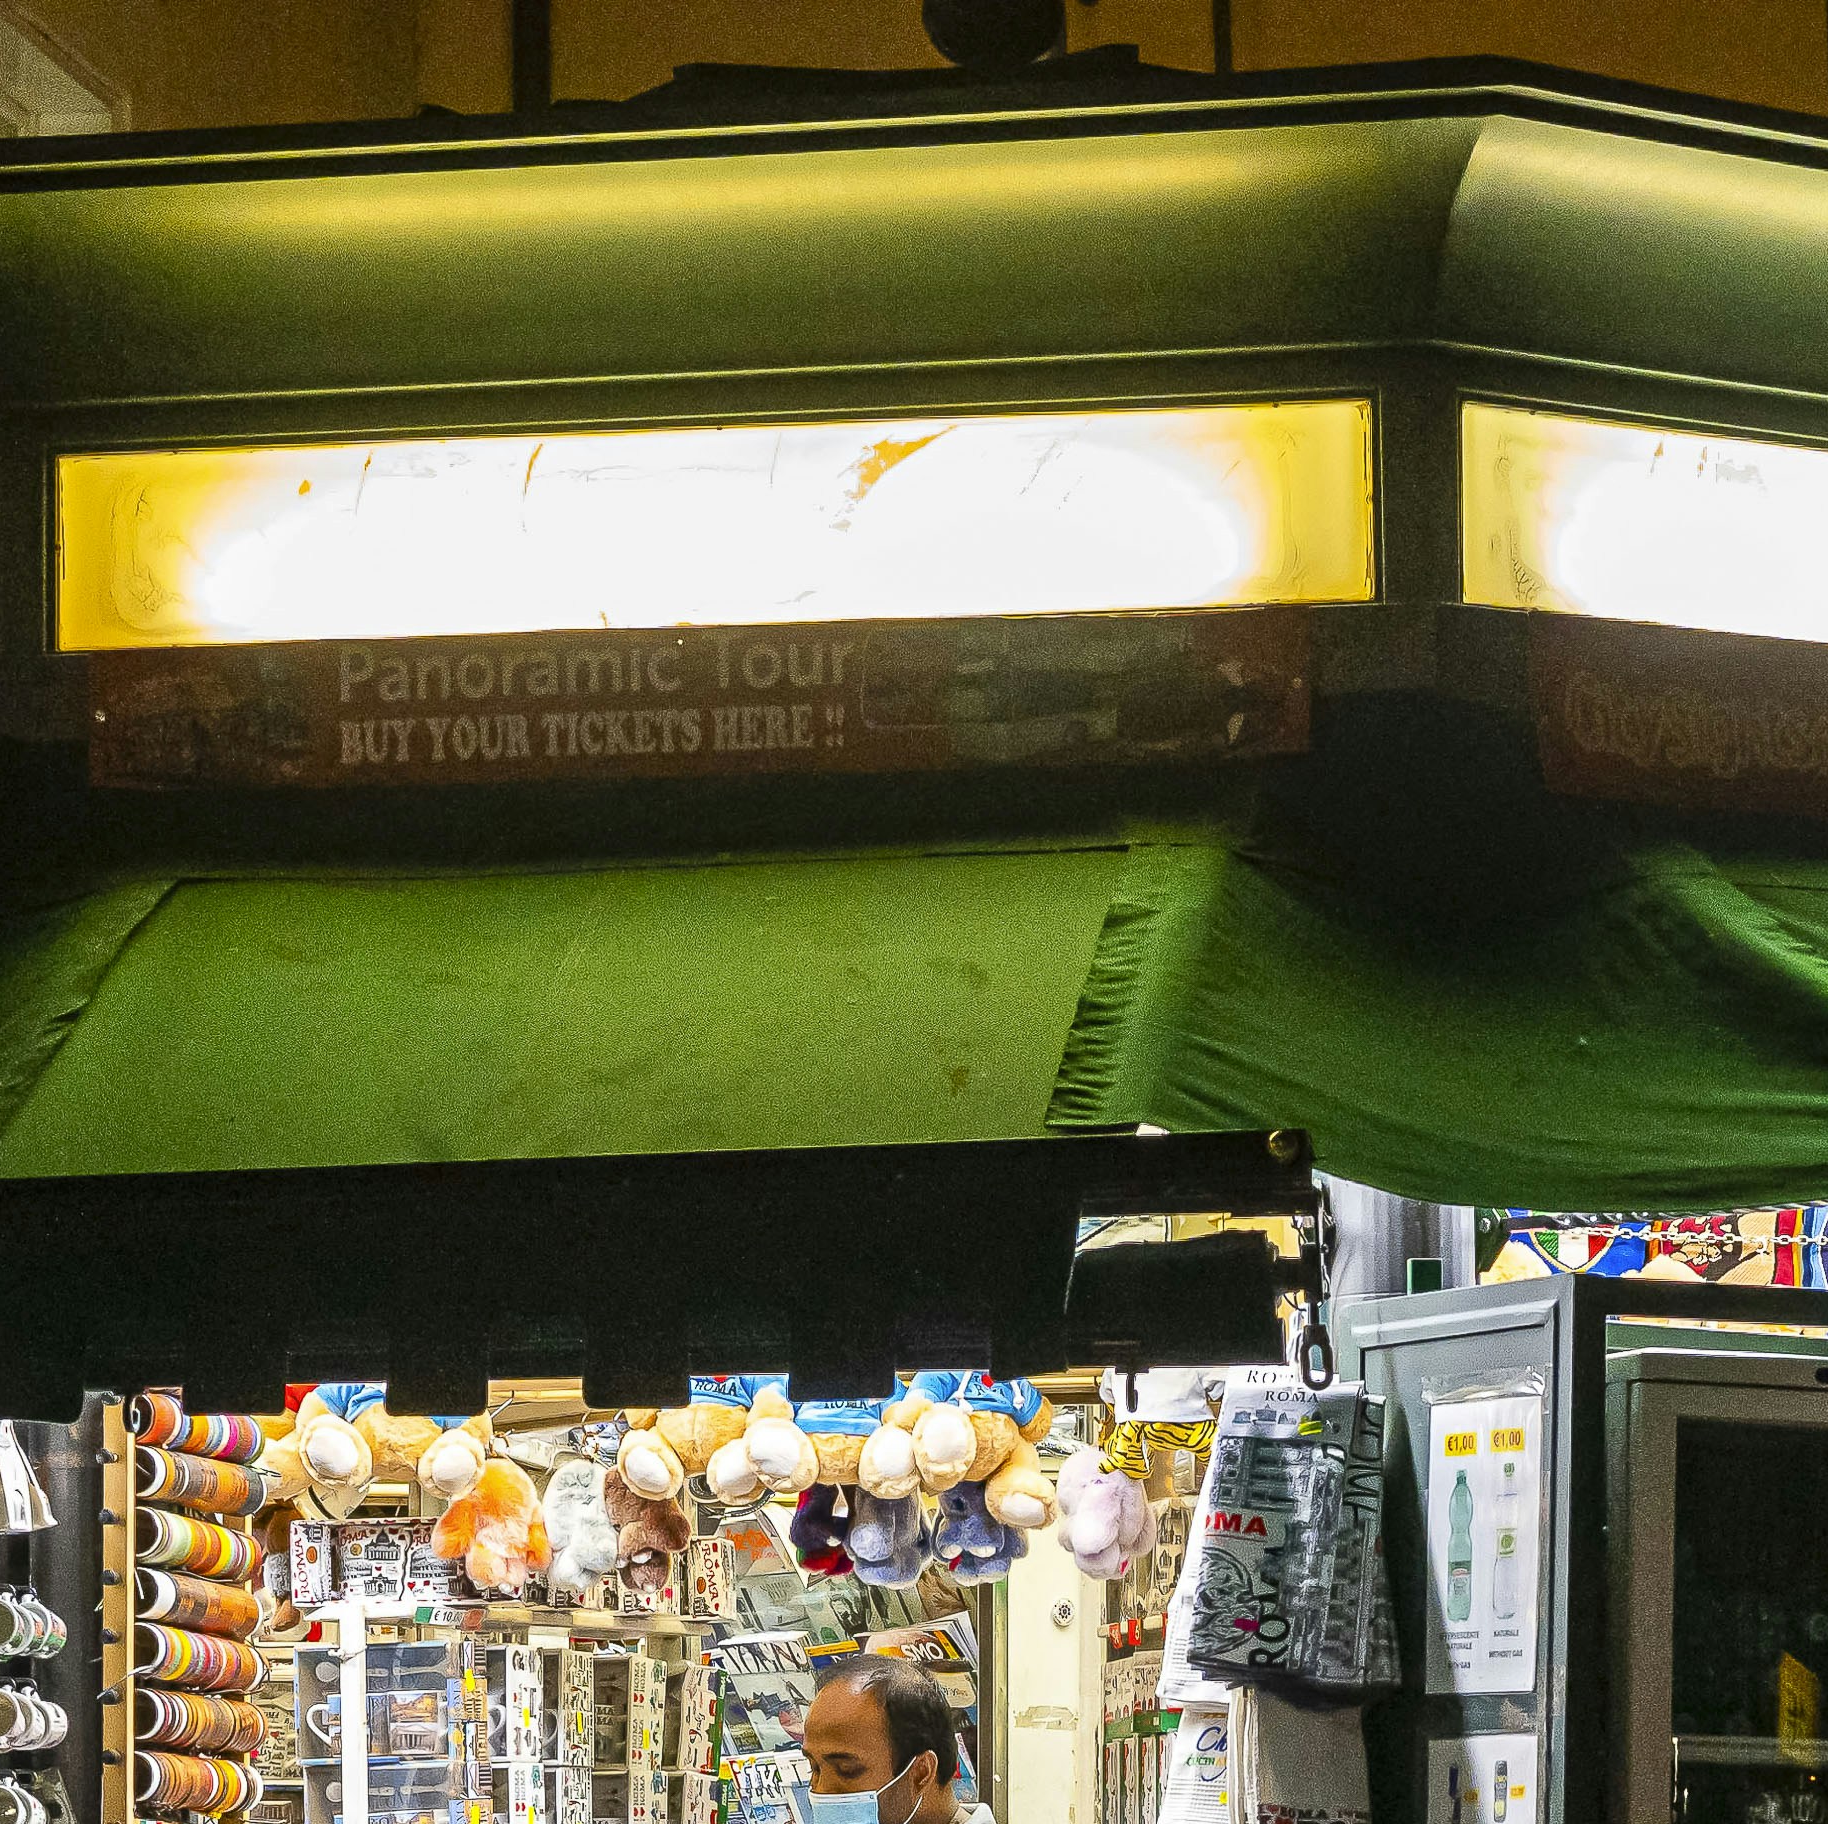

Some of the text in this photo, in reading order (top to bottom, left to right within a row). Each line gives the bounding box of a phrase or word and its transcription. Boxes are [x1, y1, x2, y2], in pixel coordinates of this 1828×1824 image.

[338, 633, 855, 702] Panoramic Tour
[341, 720, 412, 764] BUY
[426, 717, 530, 760] YOUR
[542, 710, 699, 756] TICKETS
[713, 706, 813, 752] HERE
[1265, 1389, 1320, 1404] ROMA
[1447, 1439, 1474, 1452] €1,00
[1493, 1431, 1521, 1446] €1,00
[294, 1537, 310, 1594] ROMA
[701, 1544, 719, 1601] ROMA
